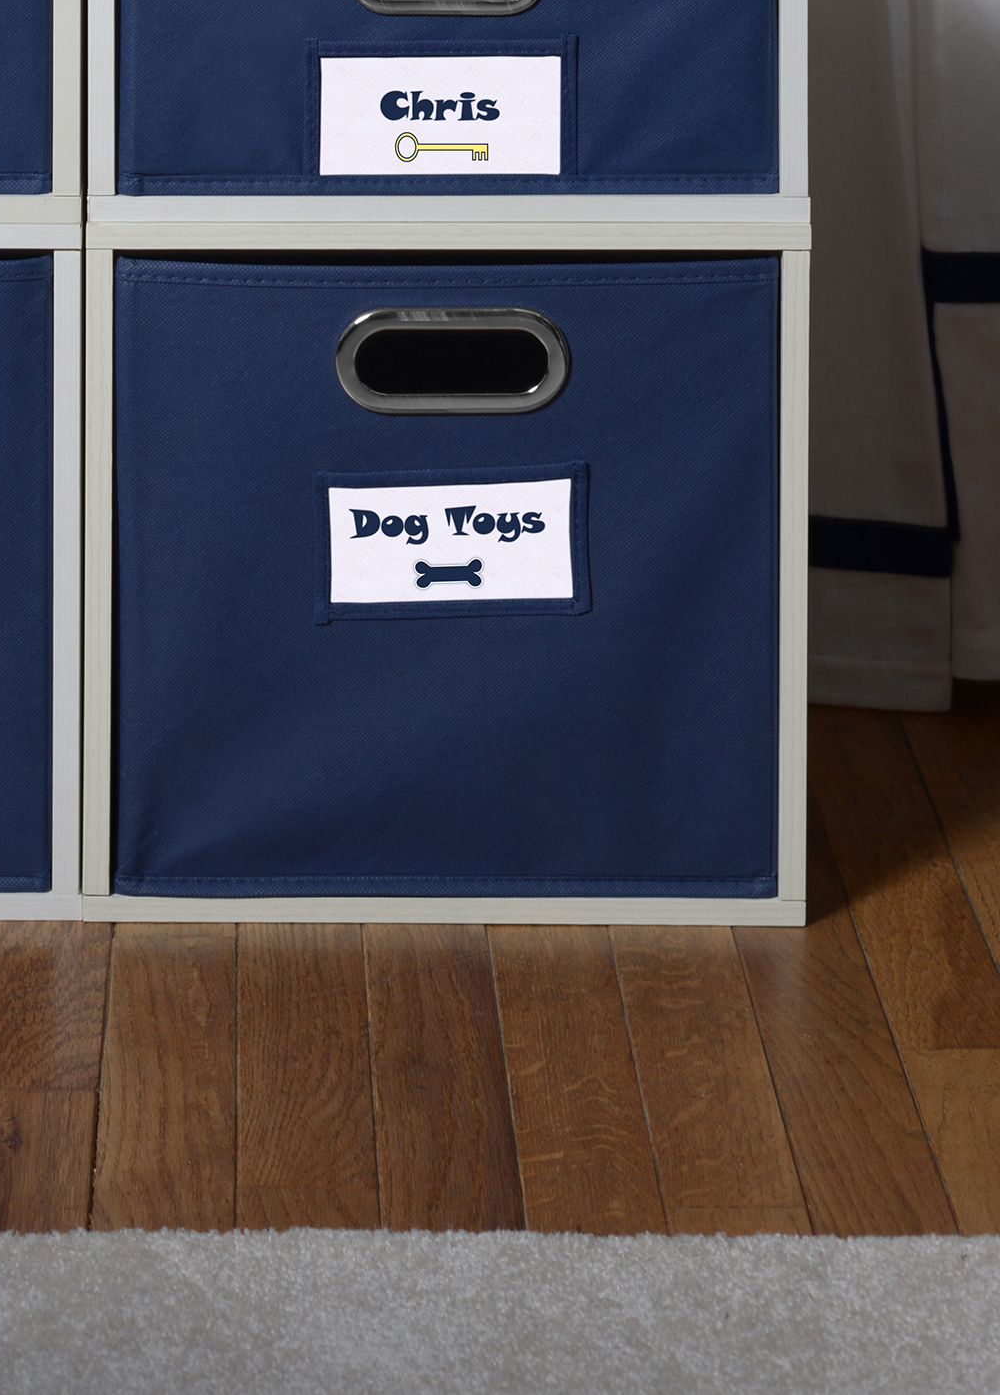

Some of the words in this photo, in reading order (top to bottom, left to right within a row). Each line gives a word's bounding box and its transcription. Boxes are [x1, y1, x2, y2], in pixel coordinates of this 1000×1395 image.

[380, 90, 500, 121] Chris
[348, 508, 429, 545] Dog
[444, 505, 546, 542] Toys
